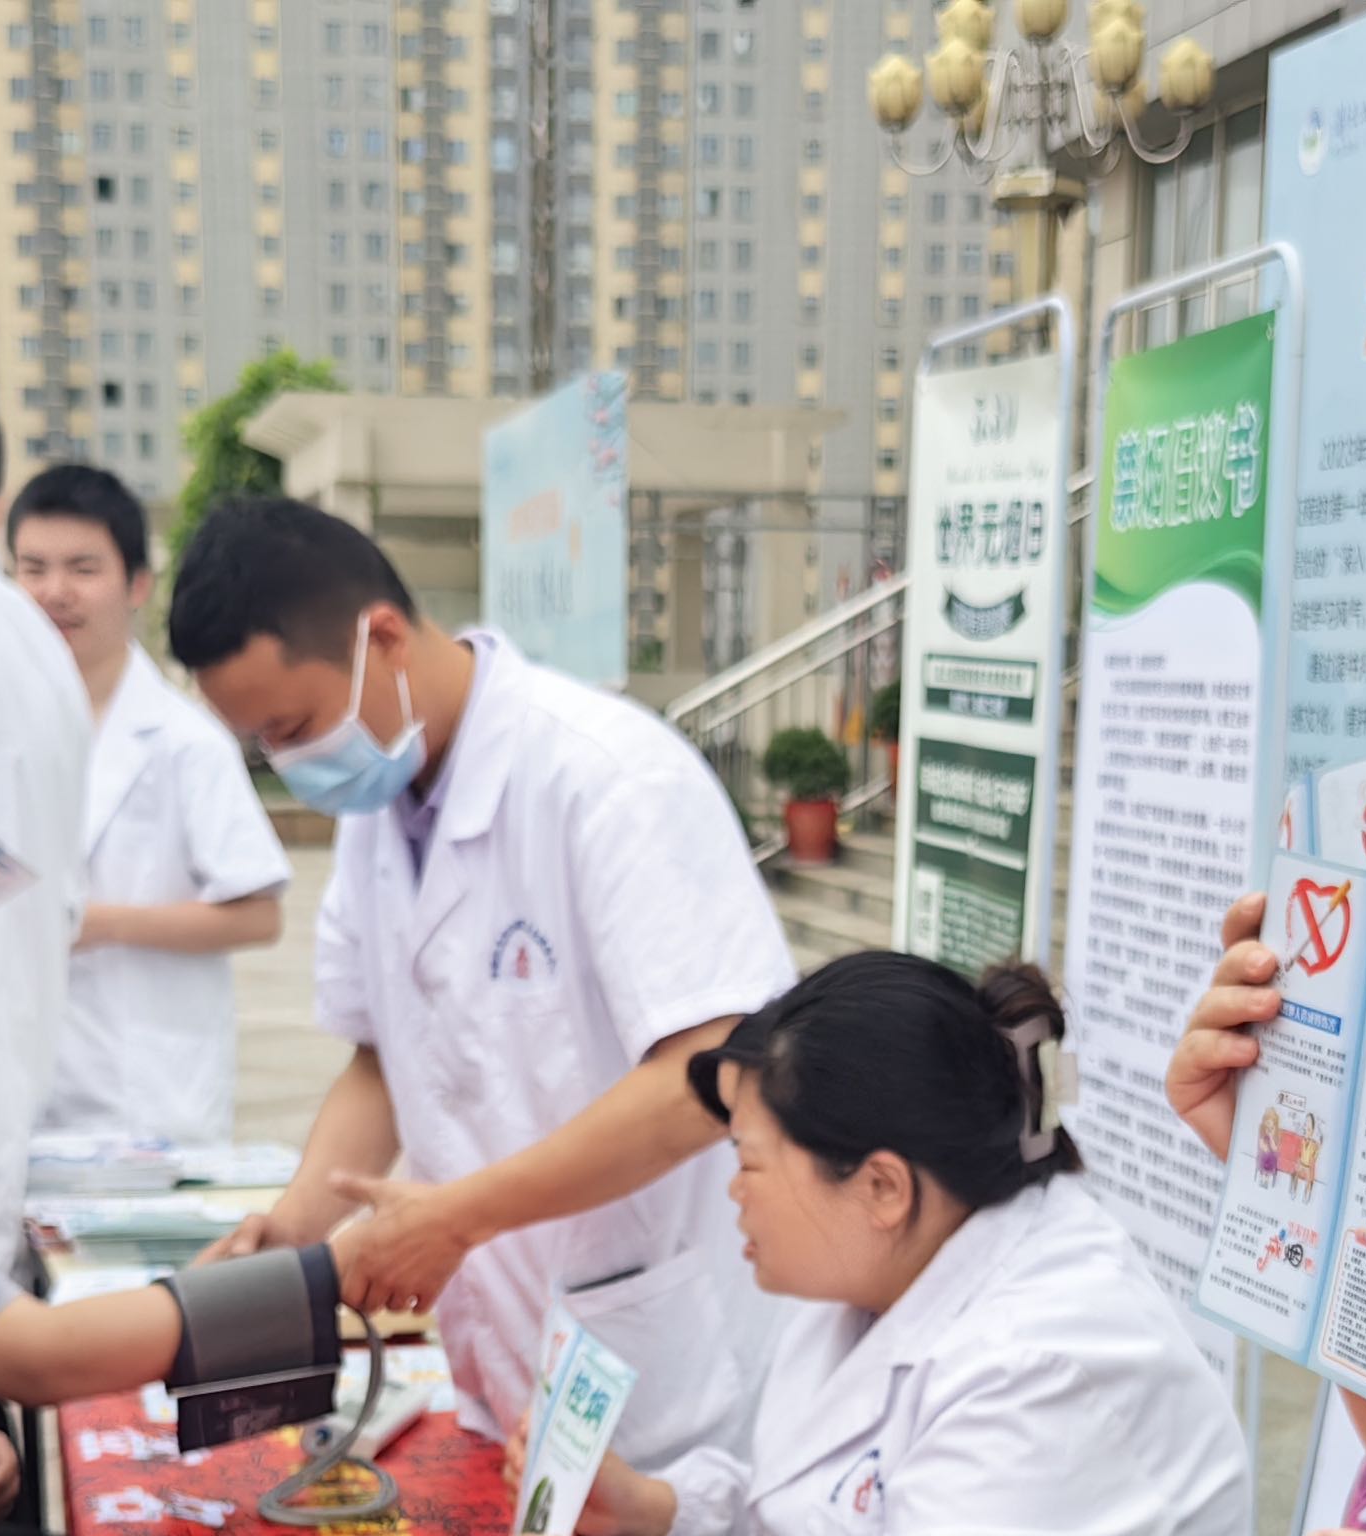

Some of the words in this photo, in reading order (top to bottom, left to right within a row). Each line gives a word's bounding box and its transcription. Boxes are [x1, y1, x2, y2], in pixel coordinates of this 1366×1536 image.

[1110, 401, 1263, 533] 禁烟倡议书
